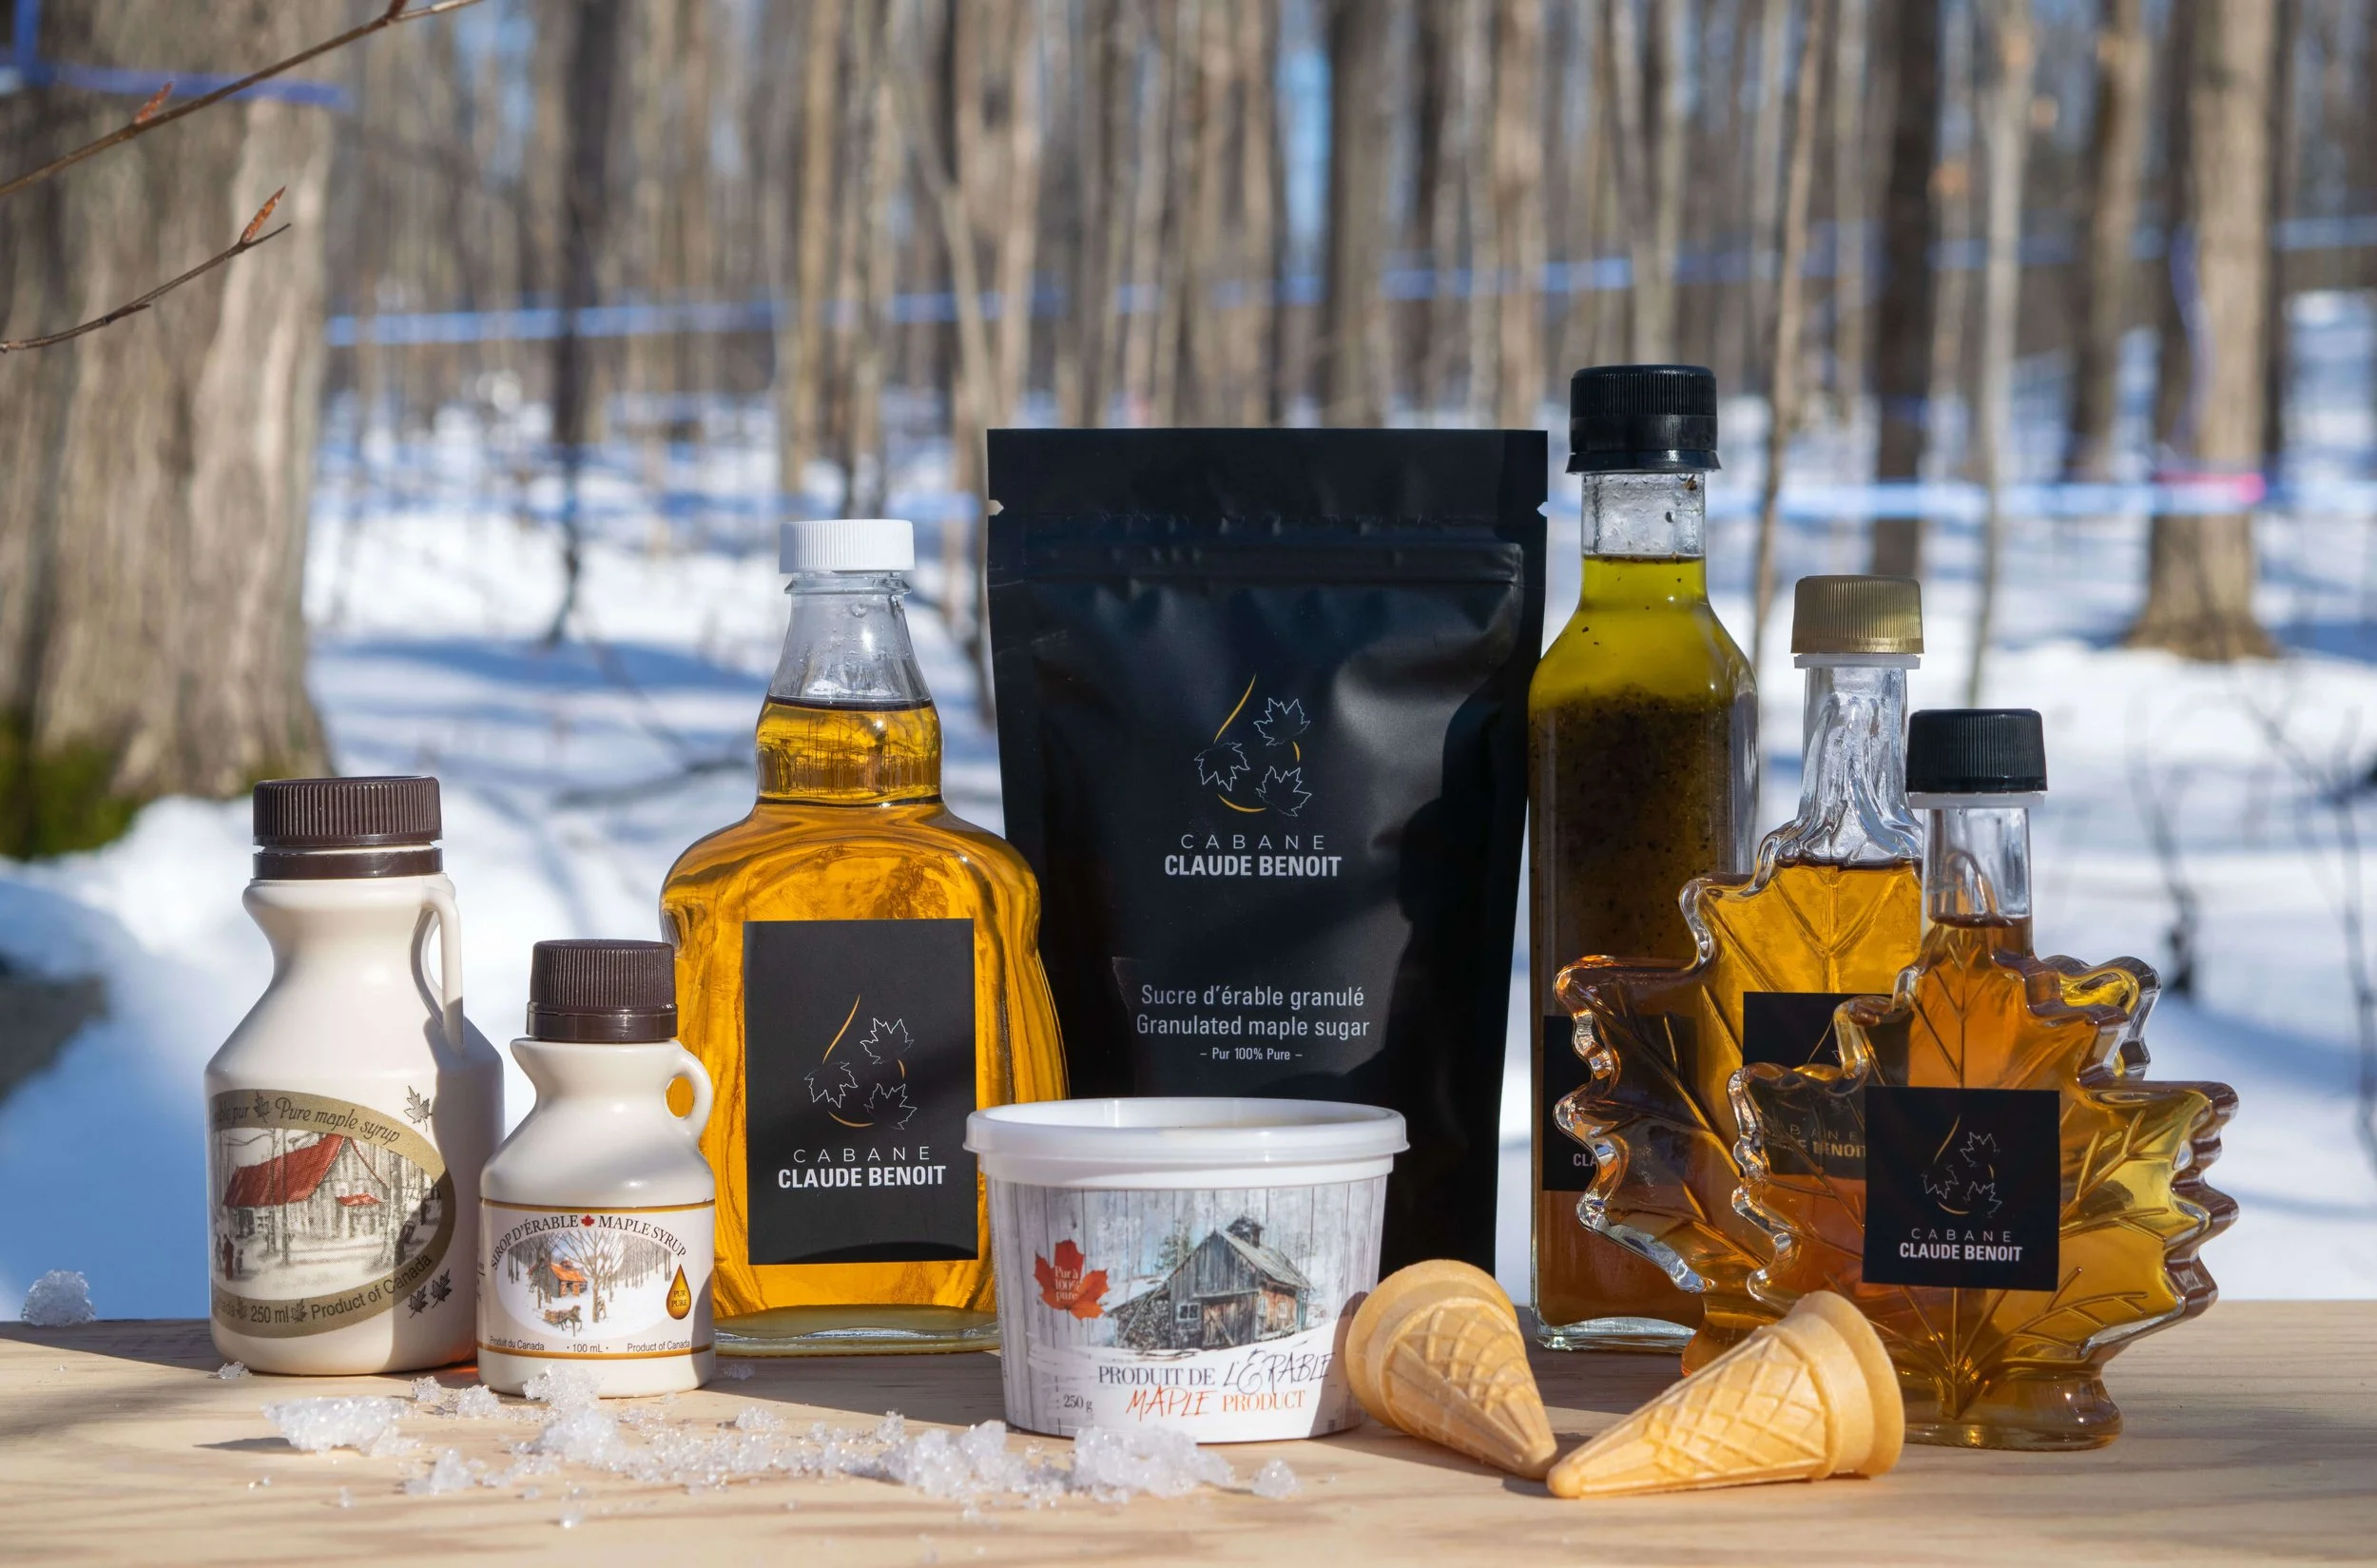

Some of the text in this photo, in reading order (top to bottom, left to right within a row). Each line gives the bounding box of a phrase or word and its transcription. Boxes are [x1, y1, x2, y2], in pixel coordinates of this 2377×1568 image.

[1181, 834, 1324, 850] CABANE
[1164, 854, 1342, 877] CLAUDE BENOIT
[1141, 984, 1364, 1010] Sucre d'érable granulé
[1136, 1014, 1370, 1041] Granulated maple sugar
[1212, 1047, 1290, 1060] Pur 100% Pure
[275, 1097, 311, 1121] Pure
[315, 1109, 358, 1131] maple
[360, 1121, 399, 1145] syrup
[793, 1146, 931, 1164] CABANE
[778, 1165, 946, 1189] CLAUDE BENOIT
[491, 1214, 579, 1271] SIROP D'ÉRABLE
[598, 1215, 686, 1258] MAPLE SYRUP
[1911, 1228, 2012, 1243] CABANE
[1900, 1242, 2022, 1262] CLAUDE BENOIT
[1055, 1266, 1071, 1279] Pur
[251, 1305, 271, 1324] 250
[275, 1305, 289, 1324] ml
[311, 1291, 366, 1320] Product
[368, 1285, 382, 1303] of
[383, 1254, 433, 1294] Canada
[673, 1289, 686, 1298] PUR
[1055, 1279, 1080, 1290] 100%
[670, 1299, 687, 1308] PURE
[1055, 1291, 1078, 1303] pure
[516, 1340, 545, 1352] Canada
[572, 1344, 603, 1353] 100 mL
[627, 1340, 690, 1352] Product of Canada
[1098, 1365, 1184, 1386] PRODUIT
[1188, 1367, 1215, 1385] DE
[1063, 1394, 1092, 1412] 250 g
[1126, 1384, 1306, 1422] MAPLE PRODUCT
